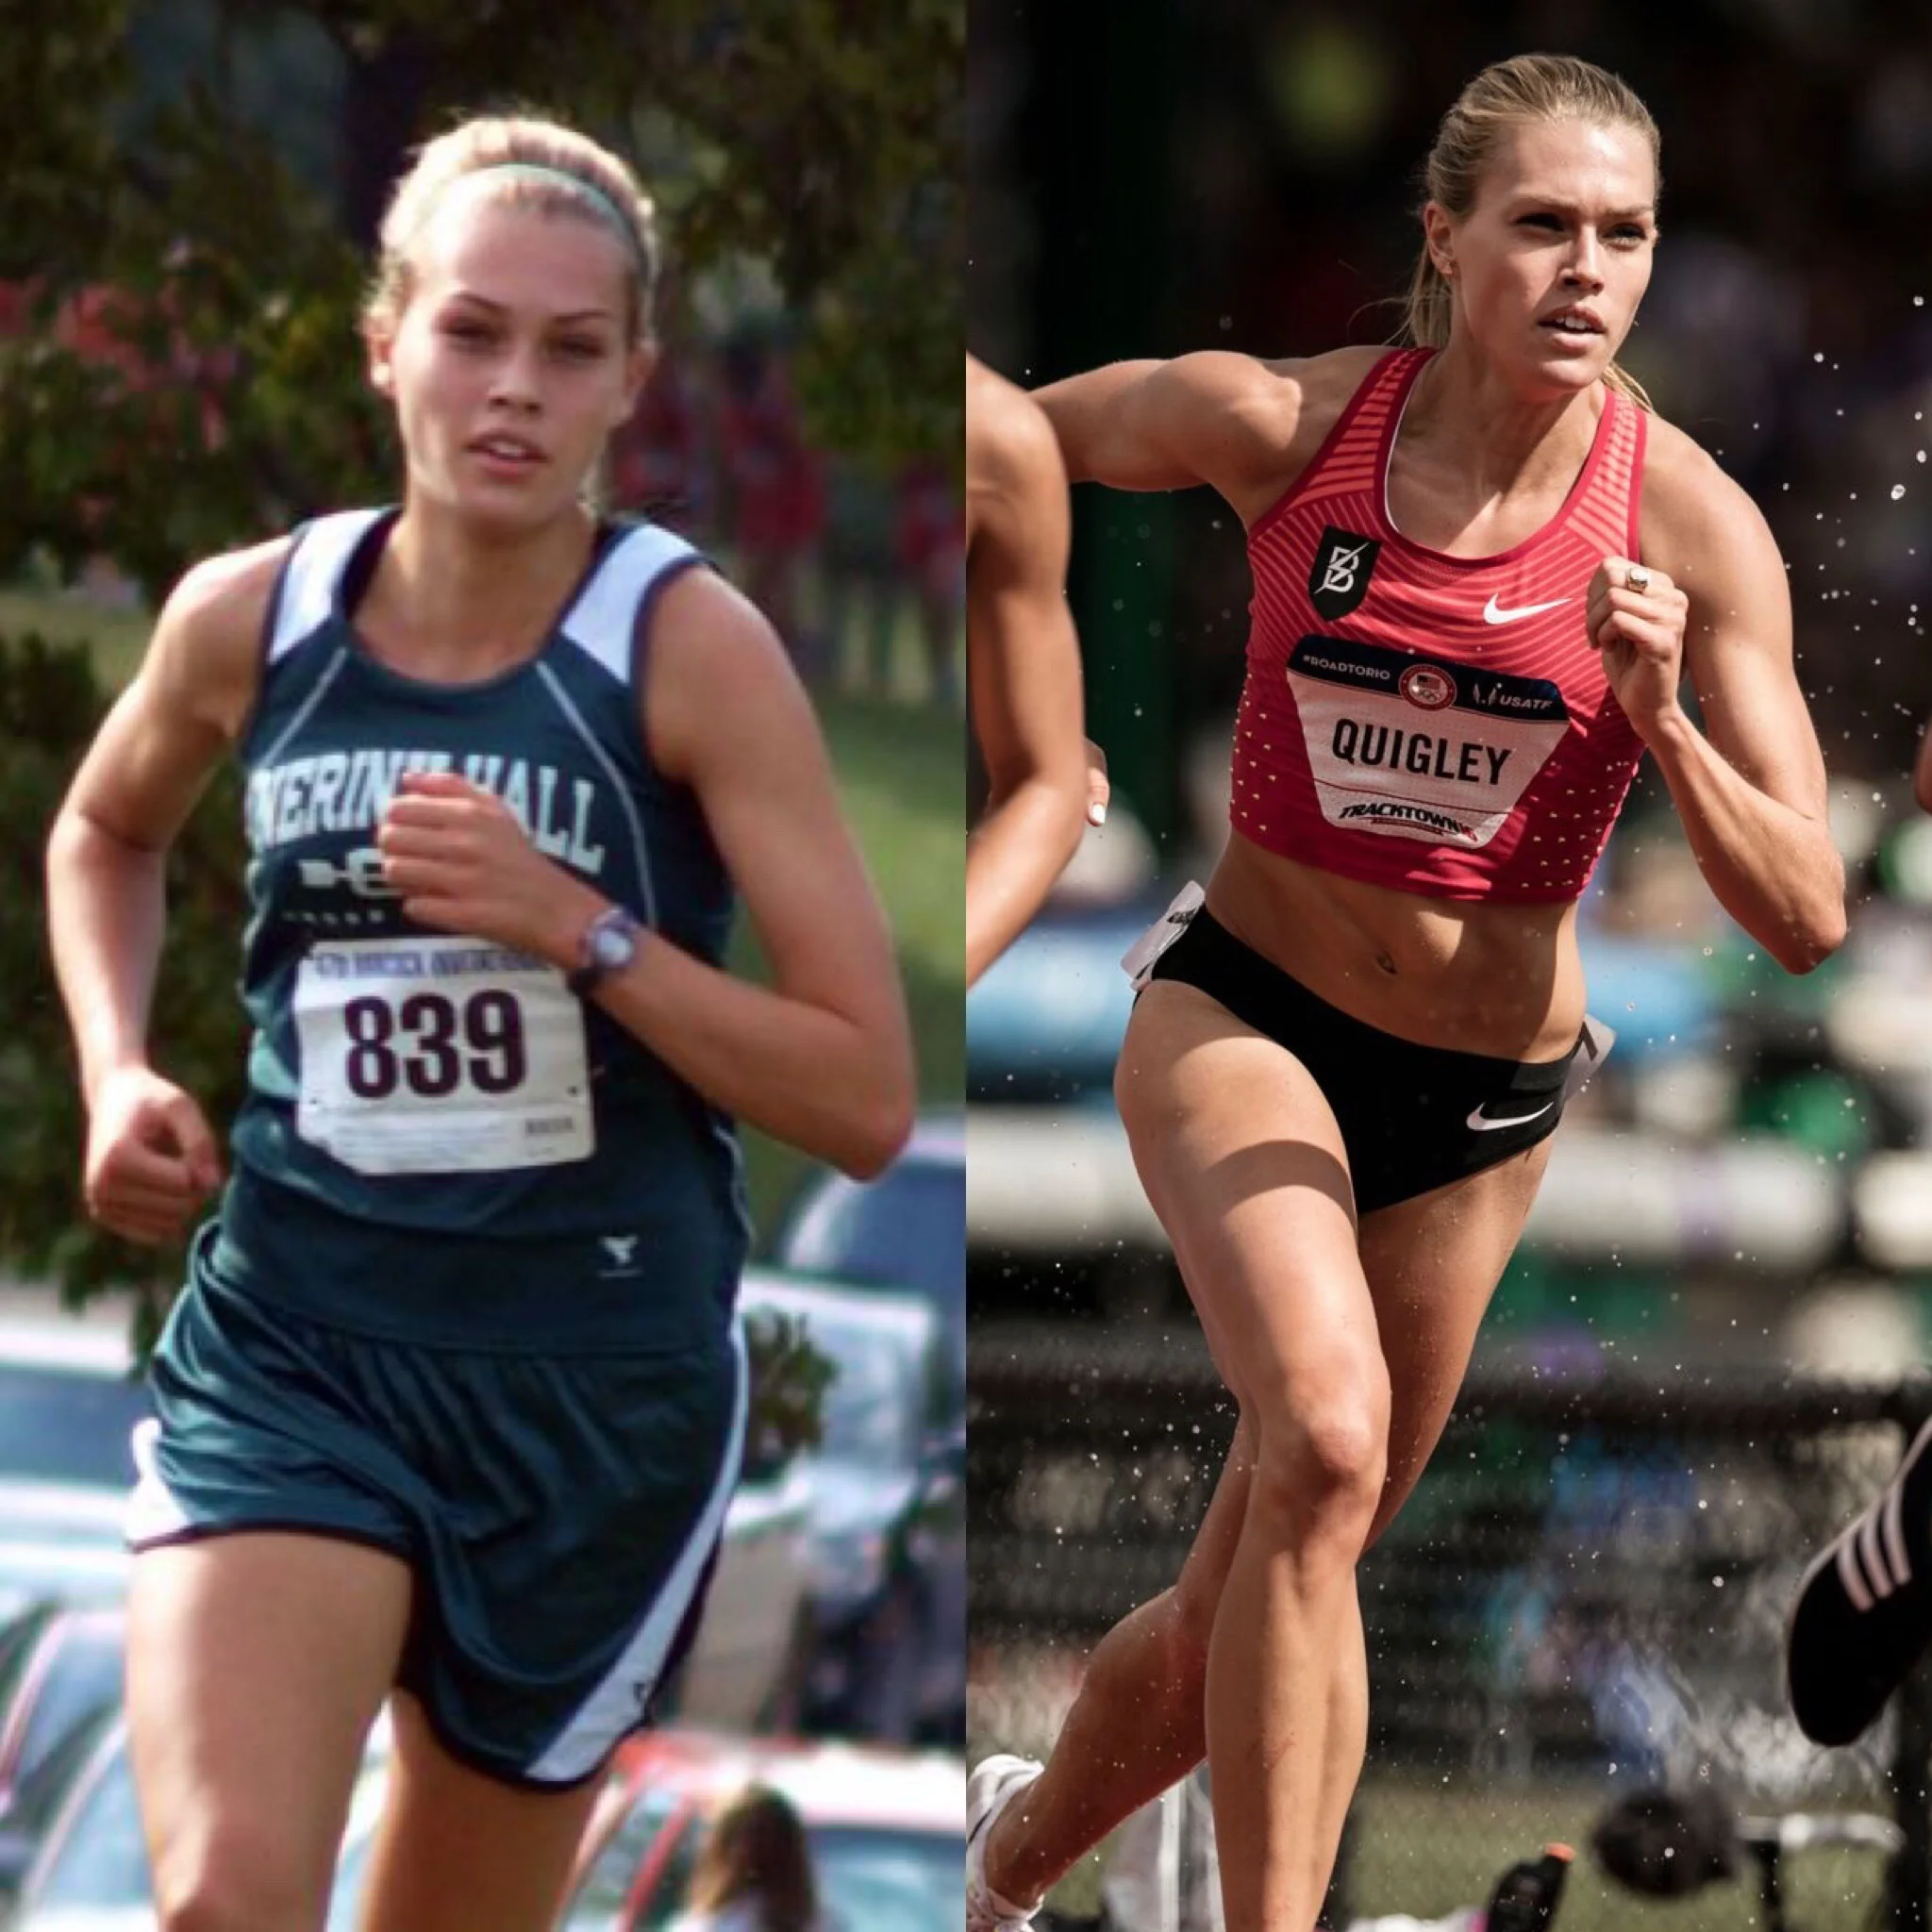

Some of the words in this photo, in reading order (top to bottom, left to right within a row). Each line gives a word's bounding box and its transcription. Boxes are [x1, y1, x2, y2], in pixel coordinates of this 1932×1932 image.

[1303, 655, 1391, 680] #ROADTORIO
[1500, 694, 1553, 710] USATF
[1331, 718, 1511, 786] QUIGLEY
[246, 750, 451, 849] NERIN
[1338, 803, 1461, 834] TRACKTOWN
[344, 989, 525, 1100] 839
